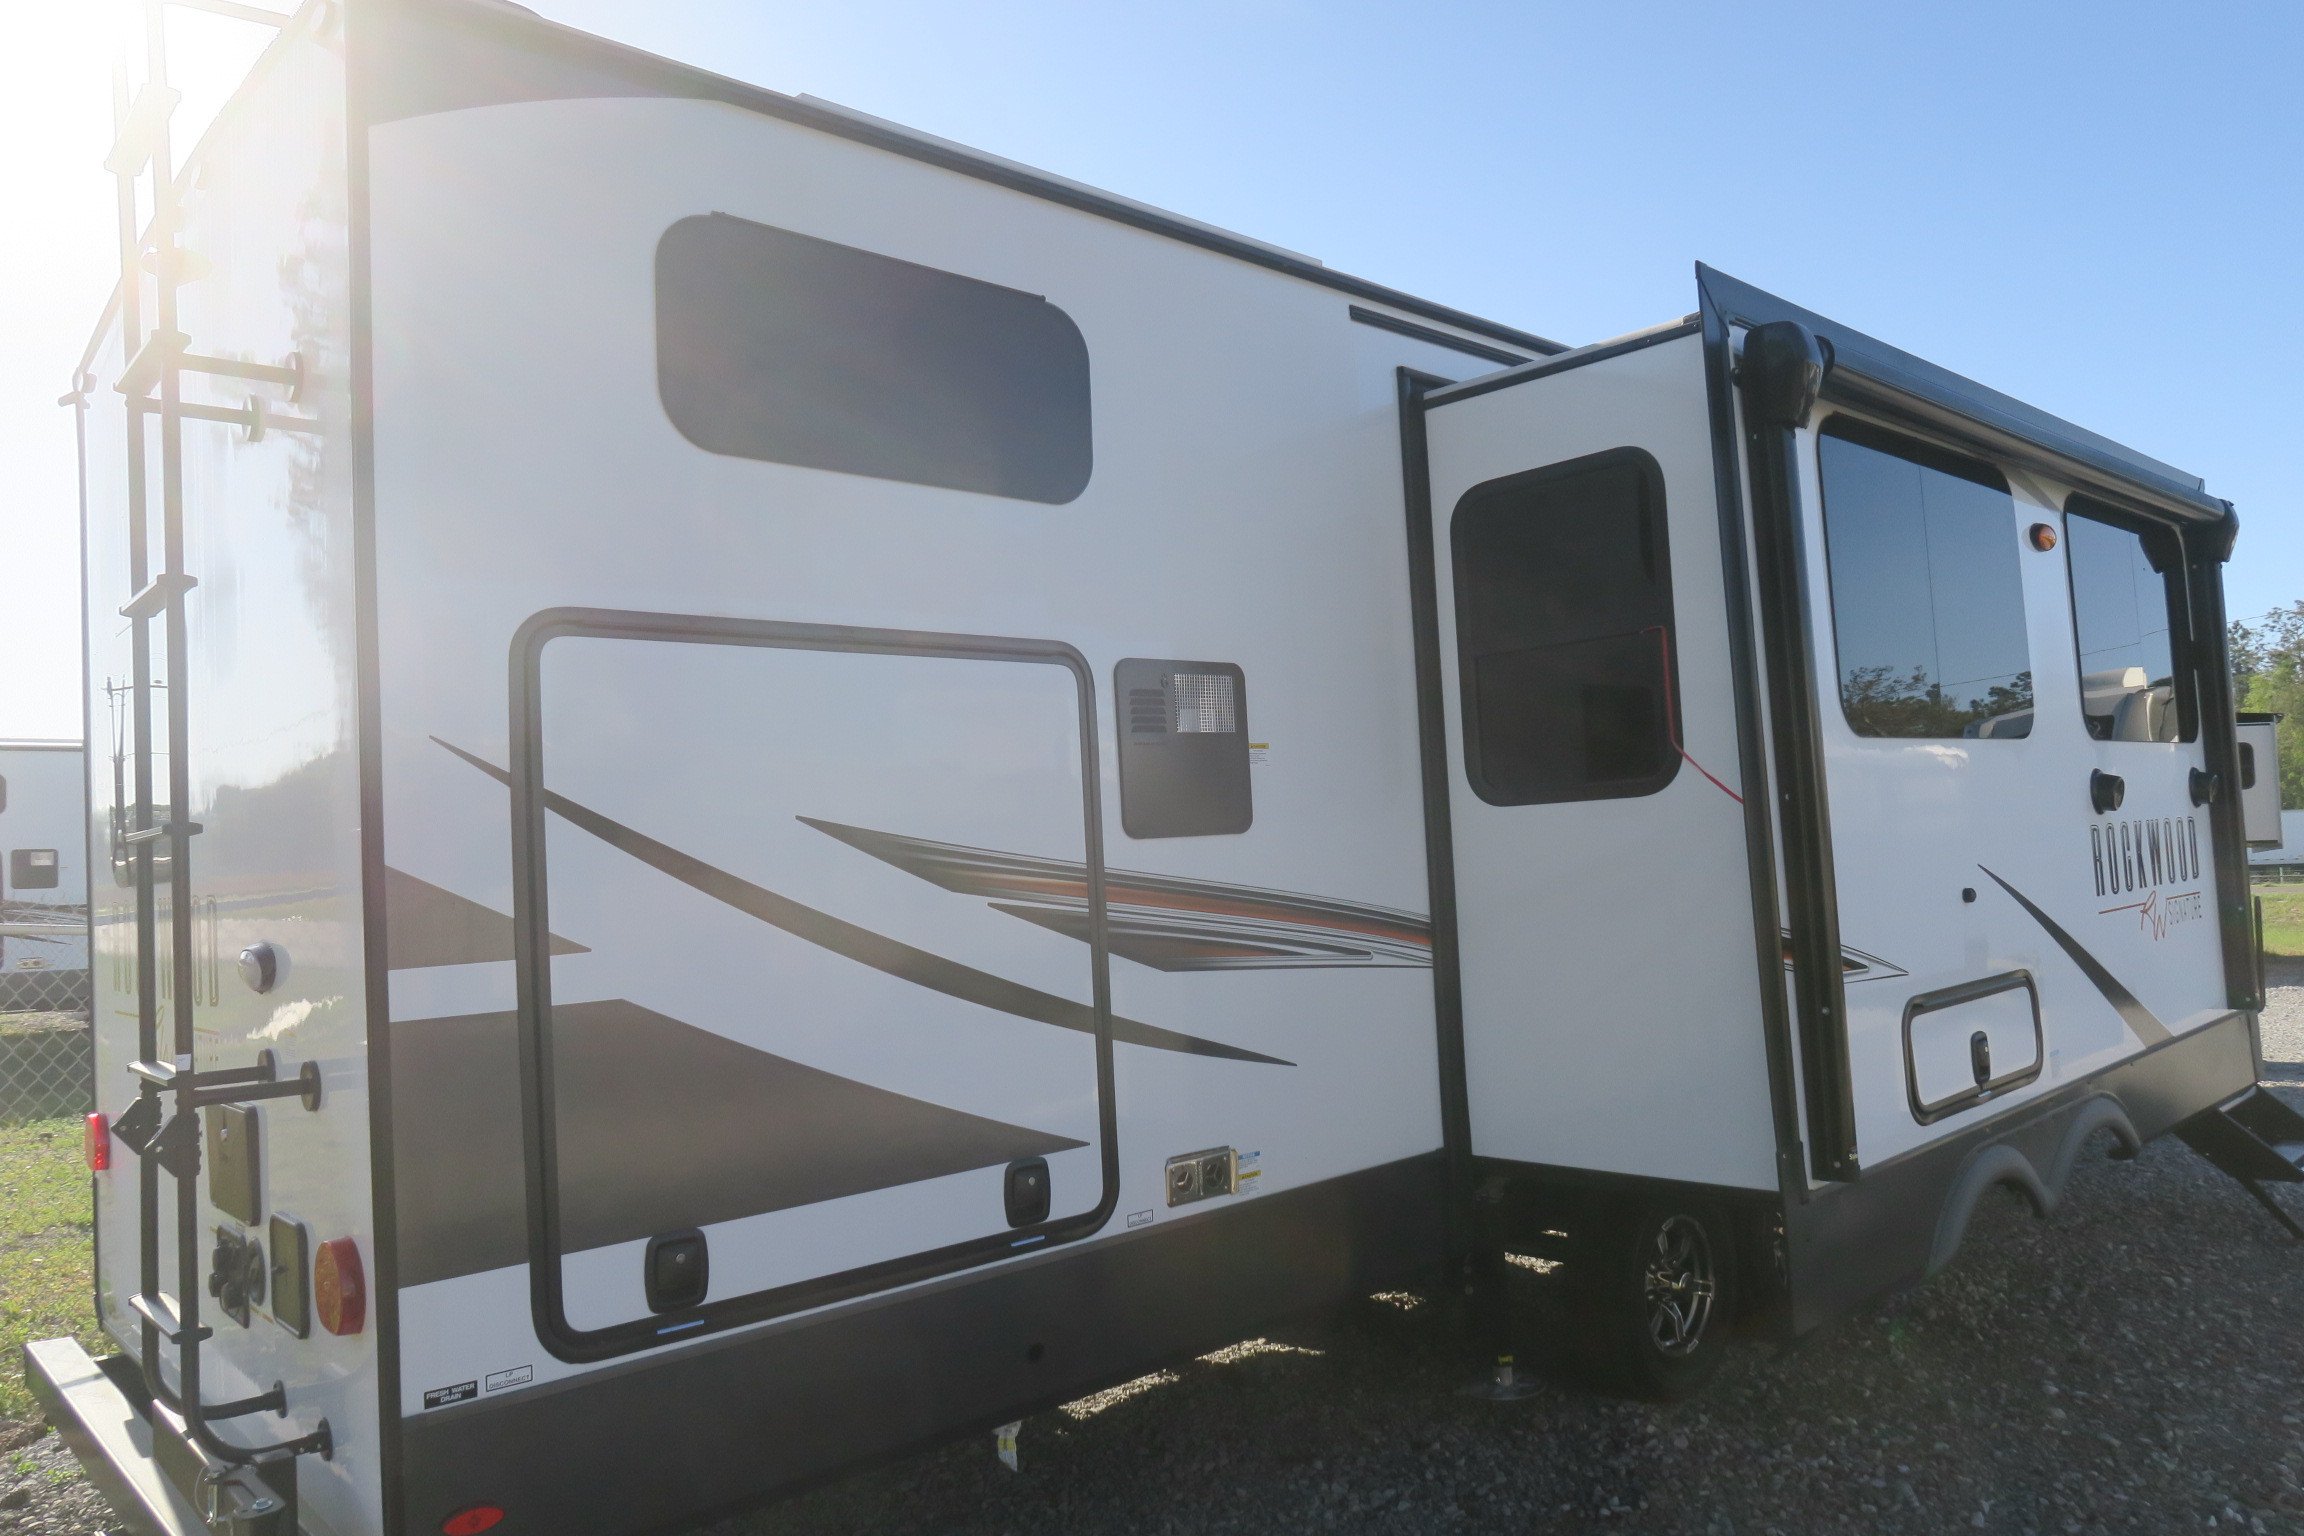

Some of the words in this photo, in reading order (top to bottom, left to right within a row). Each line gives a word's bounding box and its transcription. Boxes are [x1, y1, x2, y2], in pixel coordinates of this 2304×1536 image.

[2090, 816, 2199, 897] ROCKWOOD
[426, 1388, 449, 1400] FRESH
[451, 1383, 475, 1394] WATER
[440, 1392, 462, 1403] DRAIN
